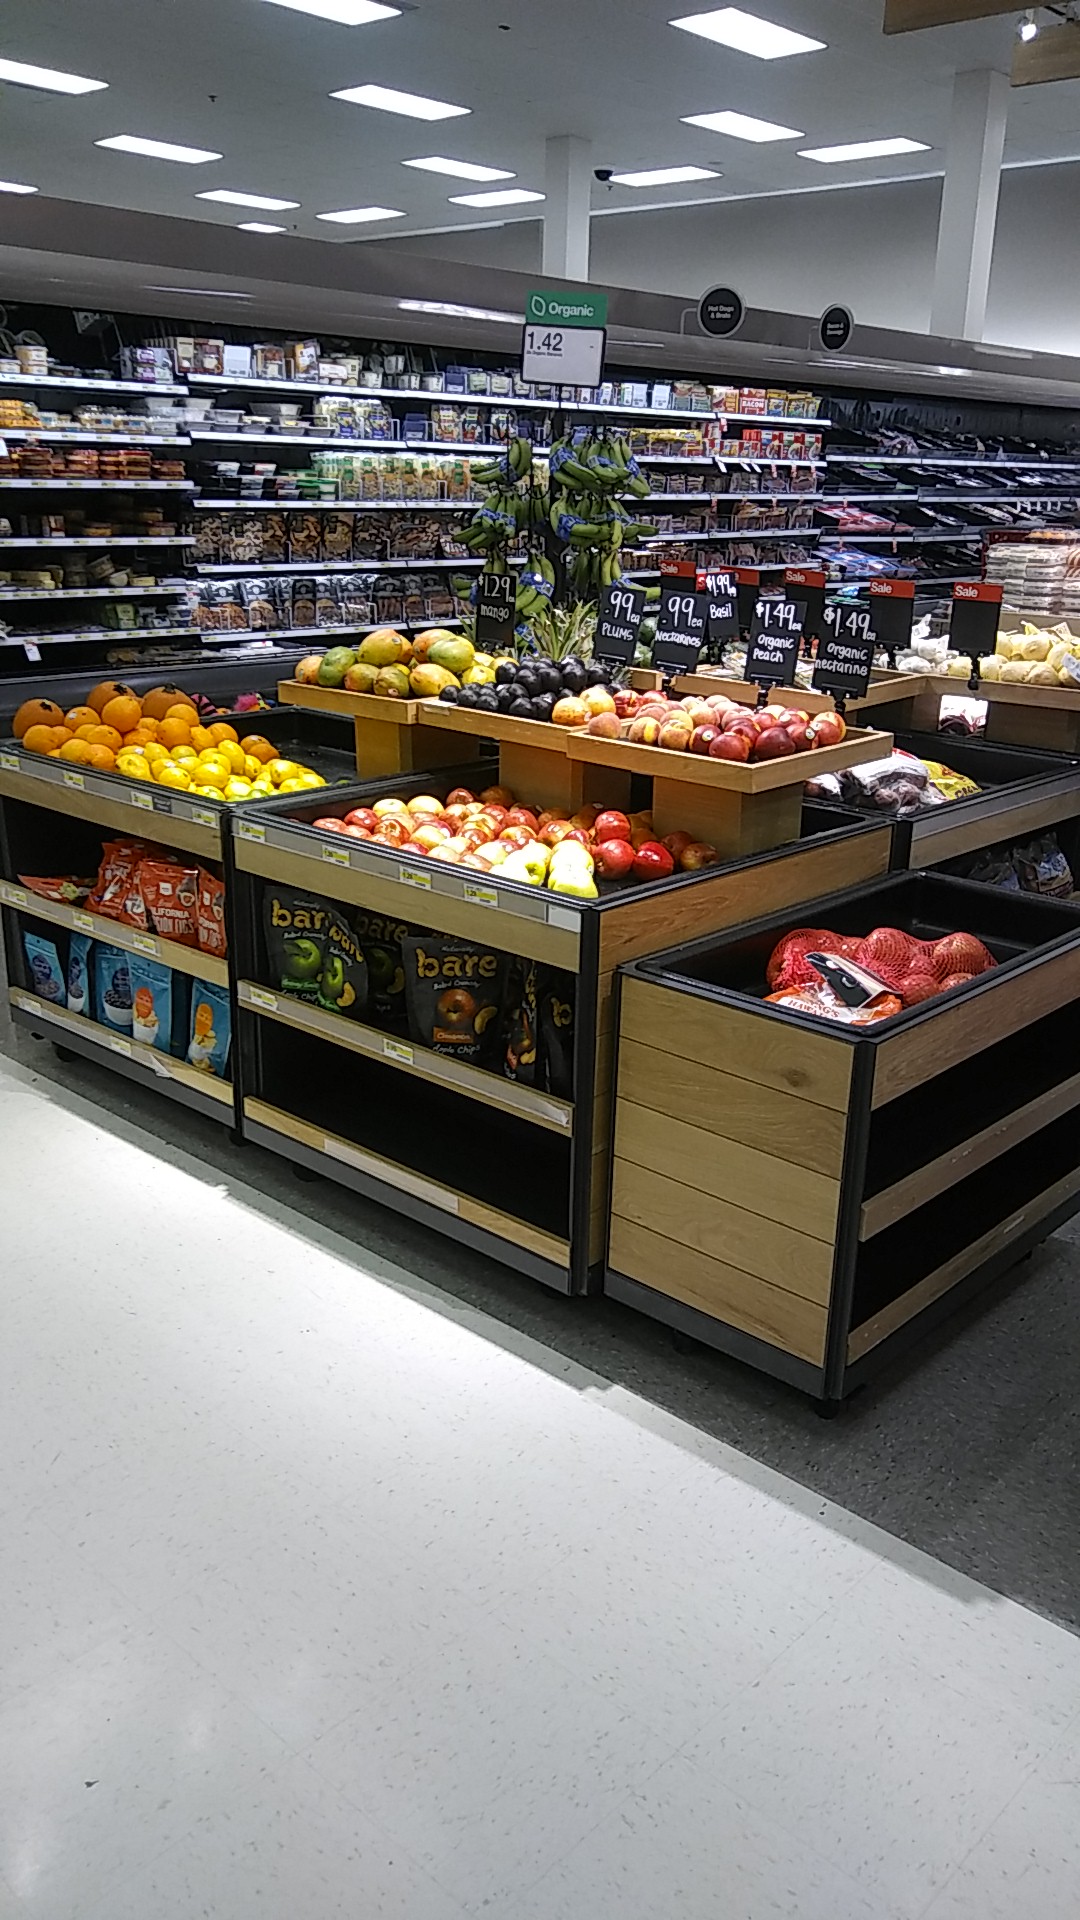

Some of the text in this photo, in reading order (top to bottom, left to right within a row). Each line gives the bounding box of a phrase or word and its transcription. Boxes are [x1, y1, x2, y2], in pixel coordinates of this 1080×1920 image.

[548, 302, 595, 318] Organic
[527, 331, 563, 352] 1.42
[660, 563, 679, 574] Sale
[786, 571, 806, 583] Sale
[478, 573, 511, 603] $1.29
[706, 574, 731, 597] $1.99
[871, 582, 893, 594] Sale
[955, 585, 979, 598] Sale
[480, 604, 510, 622] mango
[604, 591, 635, 622] .99
[661, 596, 695, 628] .99
[709, 603, 733, 619] Basil
[755, 602, 796, 631] $1.49
[823, 606, 871, 640] $1.49
[602, 622, 634, 641] PLUMS
[655, 630, 702, 648] Nectarines
[752, 648, 784, 663] Peach
[815, 658, 868, 677] nectarine
[415, 947, 498, 978] bare
[456, 1043, 481, 1056] Chips
